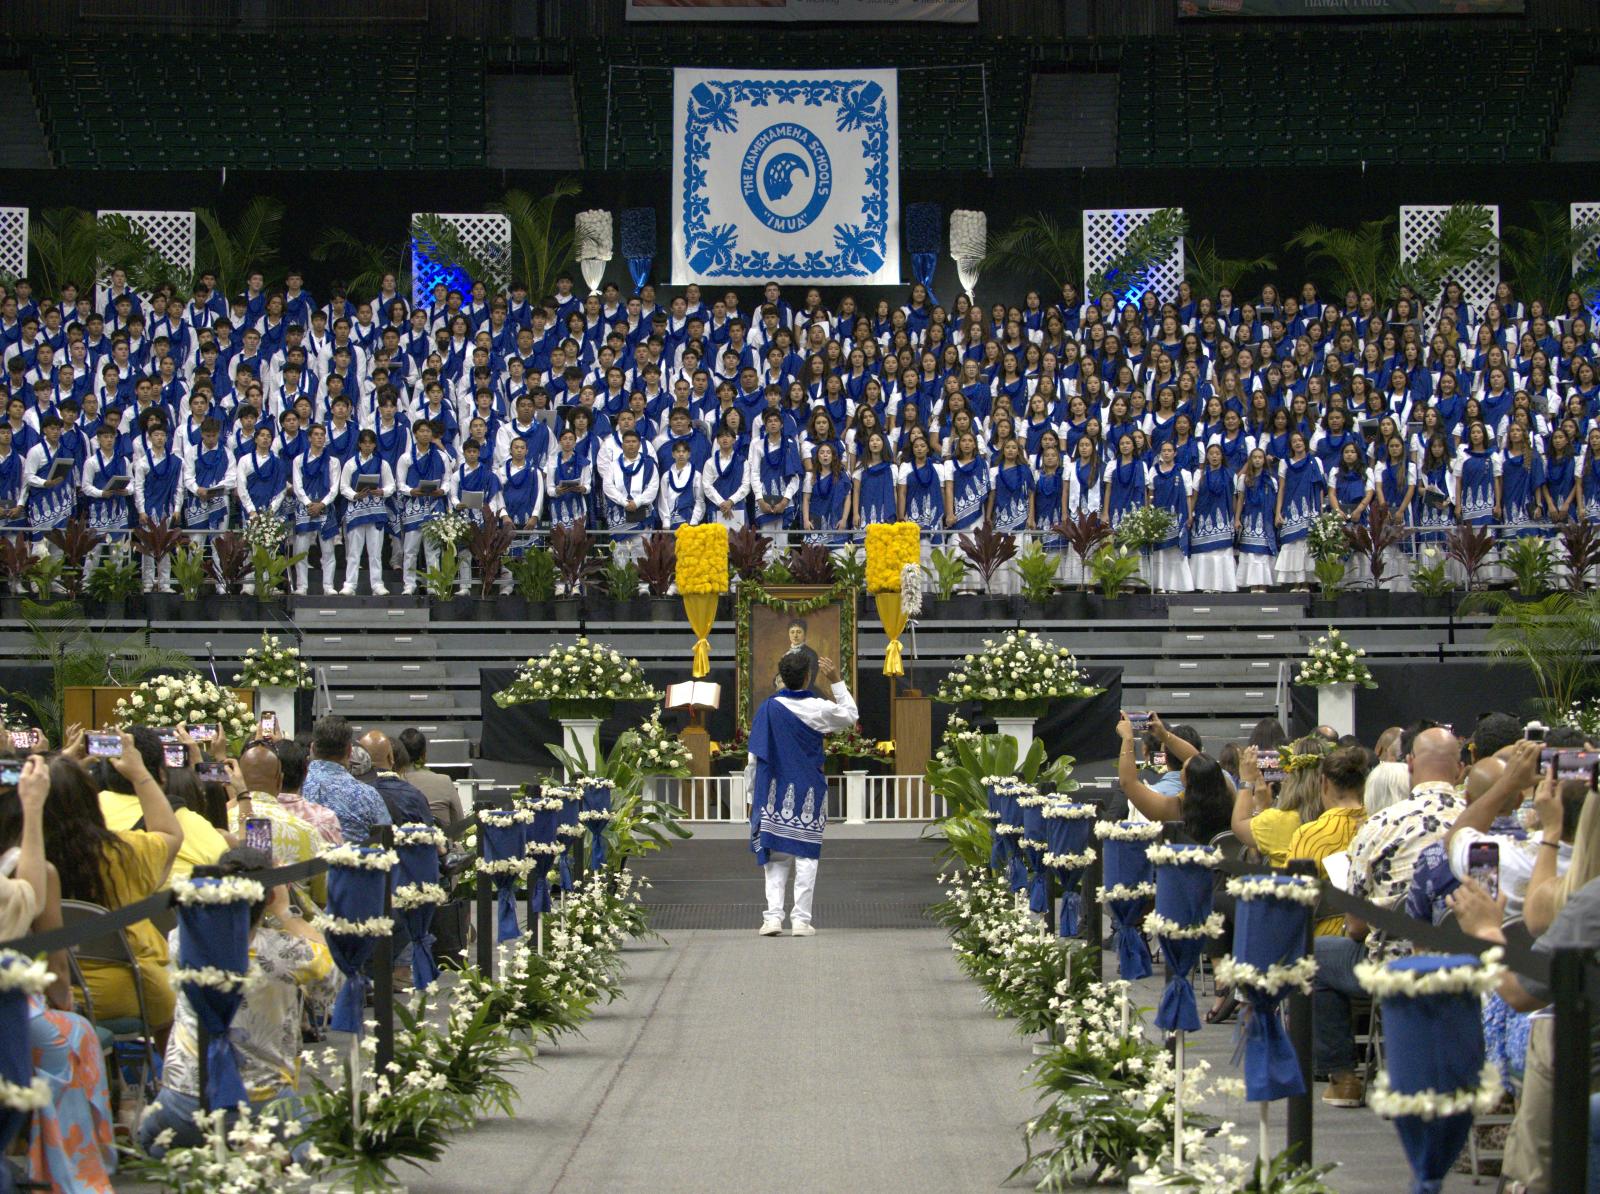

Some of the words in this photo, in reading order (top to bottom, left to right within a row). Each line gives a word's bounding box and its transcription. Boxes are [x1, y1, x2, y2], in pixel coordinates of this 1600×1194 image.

[744, 126, 808, 171] KAMEHAMEHA
[809, 141, 830, 195] SCHOOLS
[744, 174, 754, 196] THE
